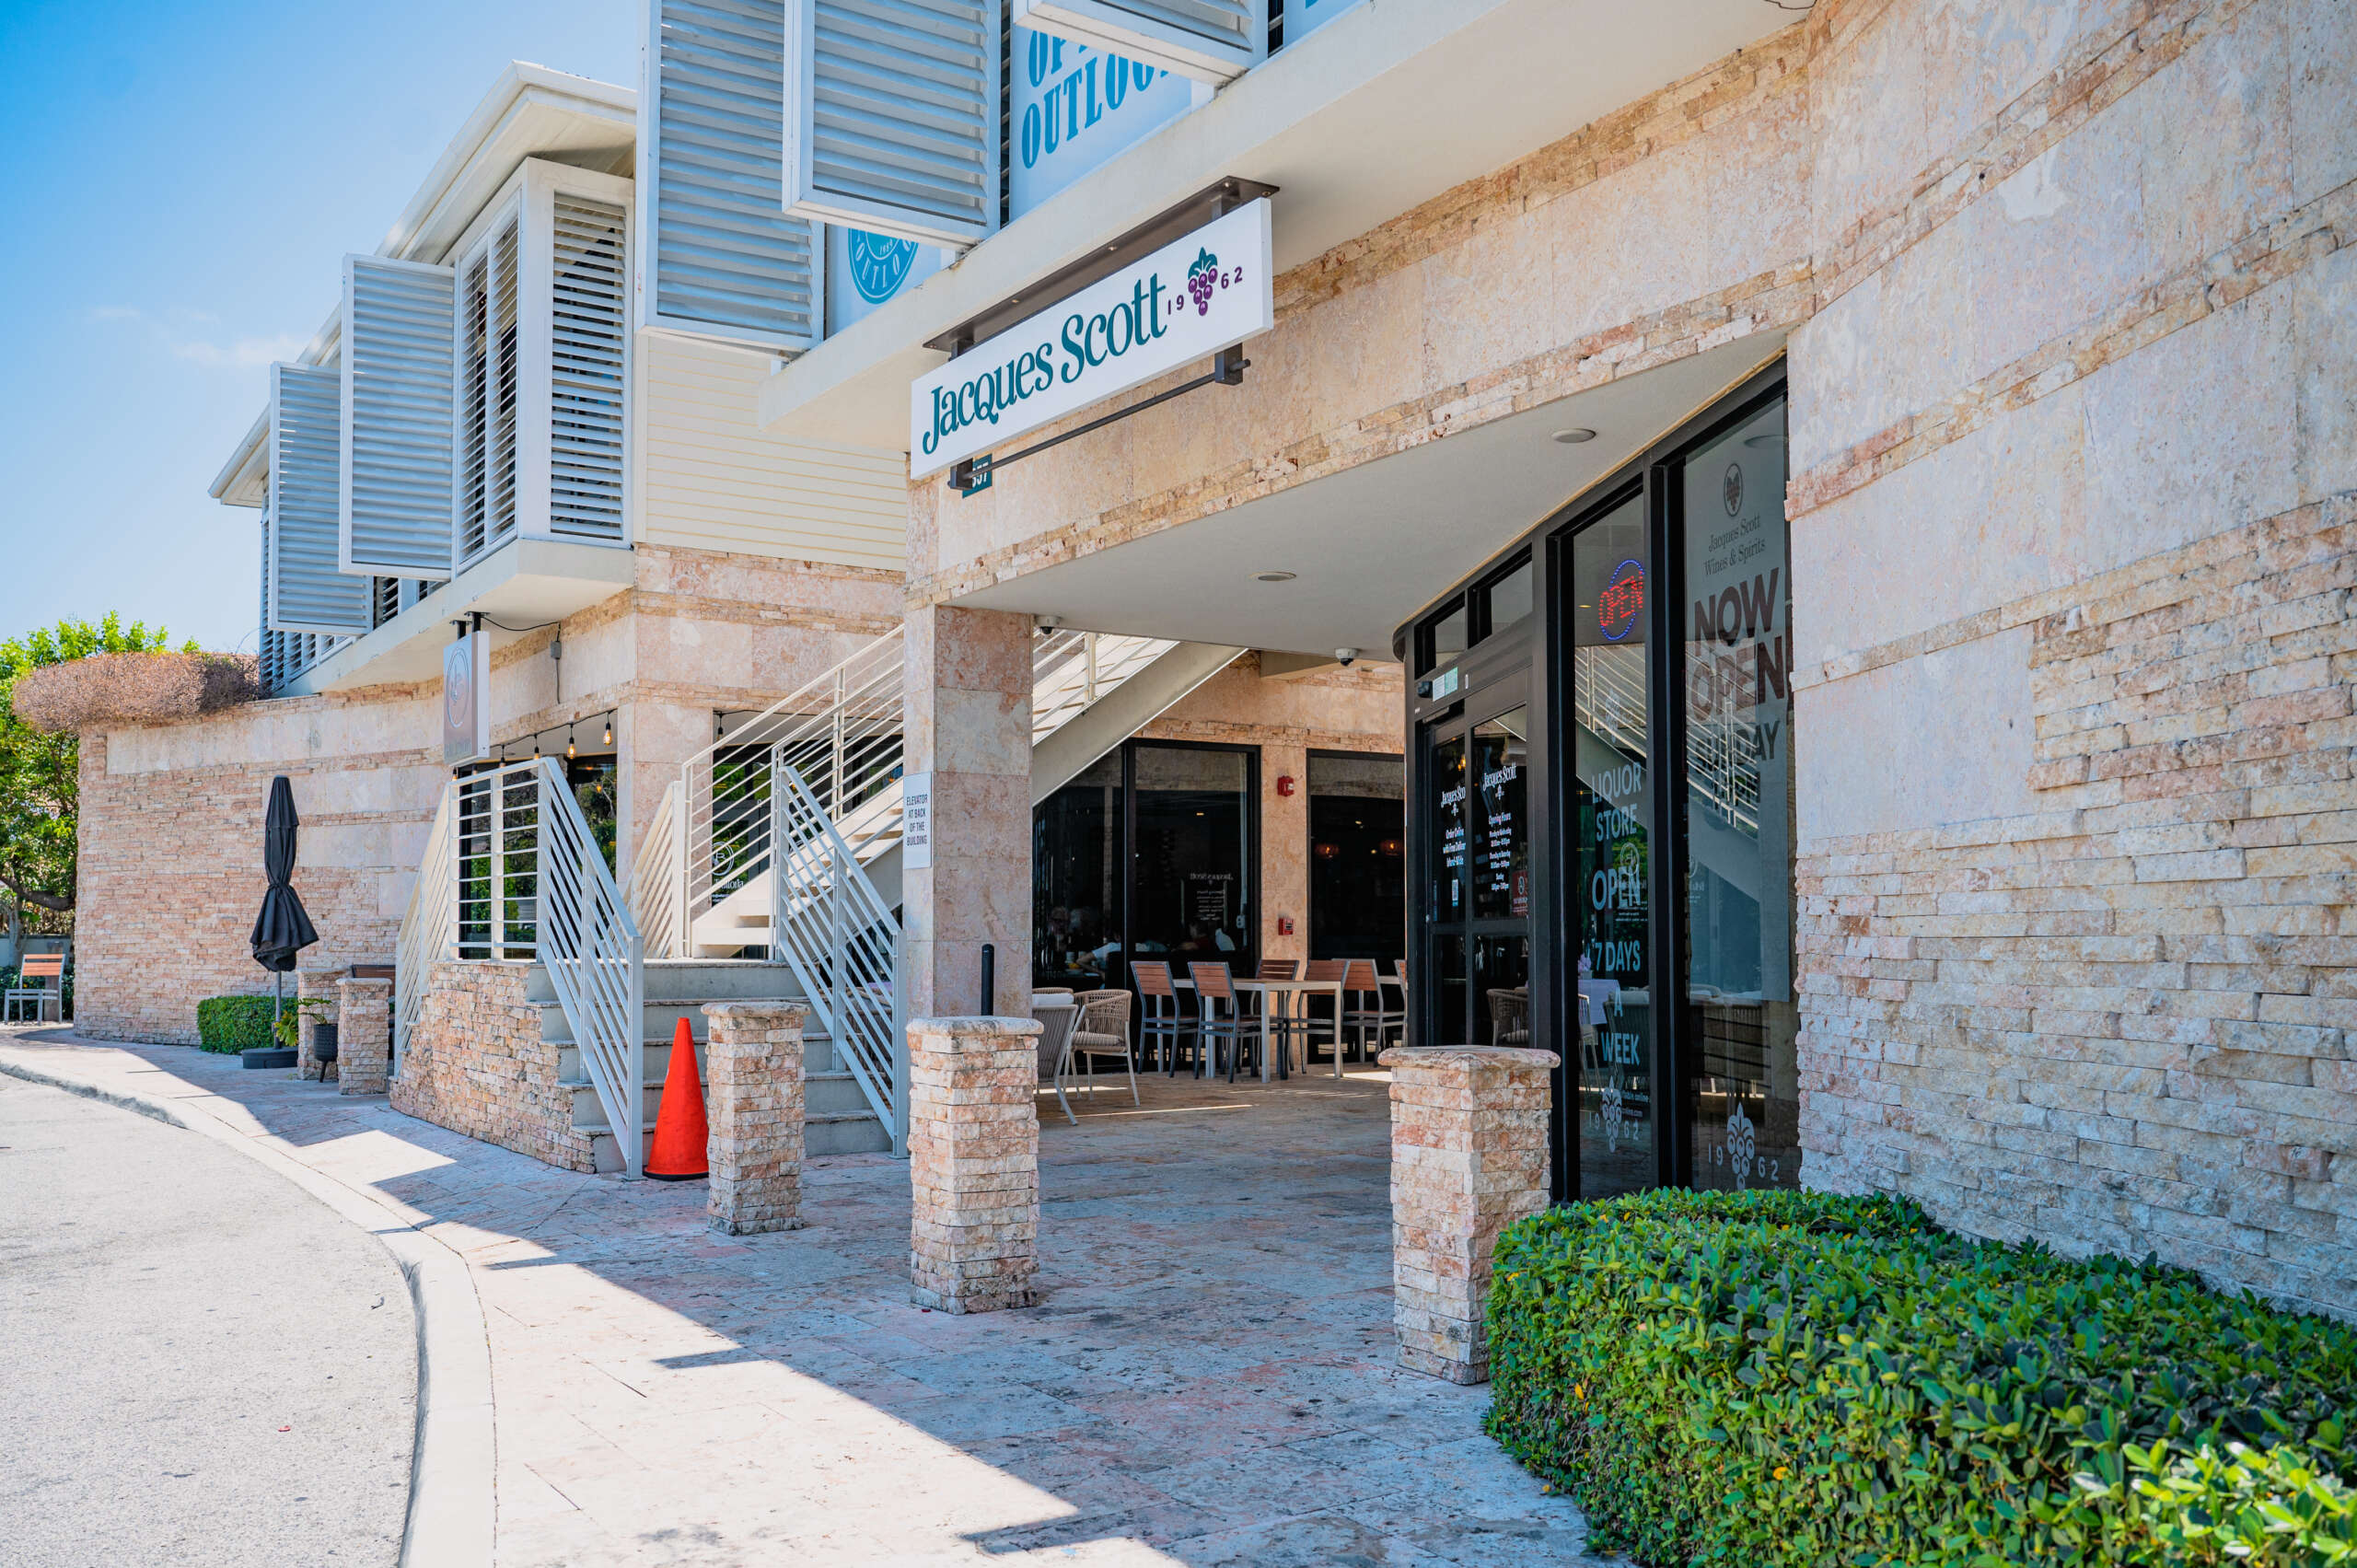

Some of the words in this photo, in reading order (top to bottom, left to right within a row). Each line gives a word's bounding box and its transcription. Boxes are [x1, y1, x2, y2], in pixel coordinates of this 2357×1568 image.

[923, 343, 1053, 455] Jacques
[1062, 273, 1167, 383] Scott
[1709, 527, 1740, 552] Jacques
[1740, 515, 1761, 538] Scott
[1703, 555, 1728, 575] Wines
[1729, 547, 1737, 567] &
[1738, 538, 1767, 564] Spirits
[1598, 571, 1643, 626] OPEN
[1694, 567, 1780, 657] NOW
[1691, 636, 1785, 722] OPEN
[1503, 761, 1517, 784] Scott
[1592, 761, 1642, 804] LIQUOR
[906, 794, 928, 806] ELEVATOR
[908, 809, 913, 818] AT
[914, 807, 925, 818] BACK
[907, 835, 927, 846] BUILDING
[910, 822, 915, 832] OF
[916, 821, 924, 831] THE
[1596, 803, 1638, 842] STORE
[1592, 864, 1641, 911] OPEN
[1596, 943, 1603, 971] 7
[1606, 939, 1641, 972] DAYS
[1614, 986, 1623, 1017] A
[1600, 1030, 1640, 1065] WEEK
